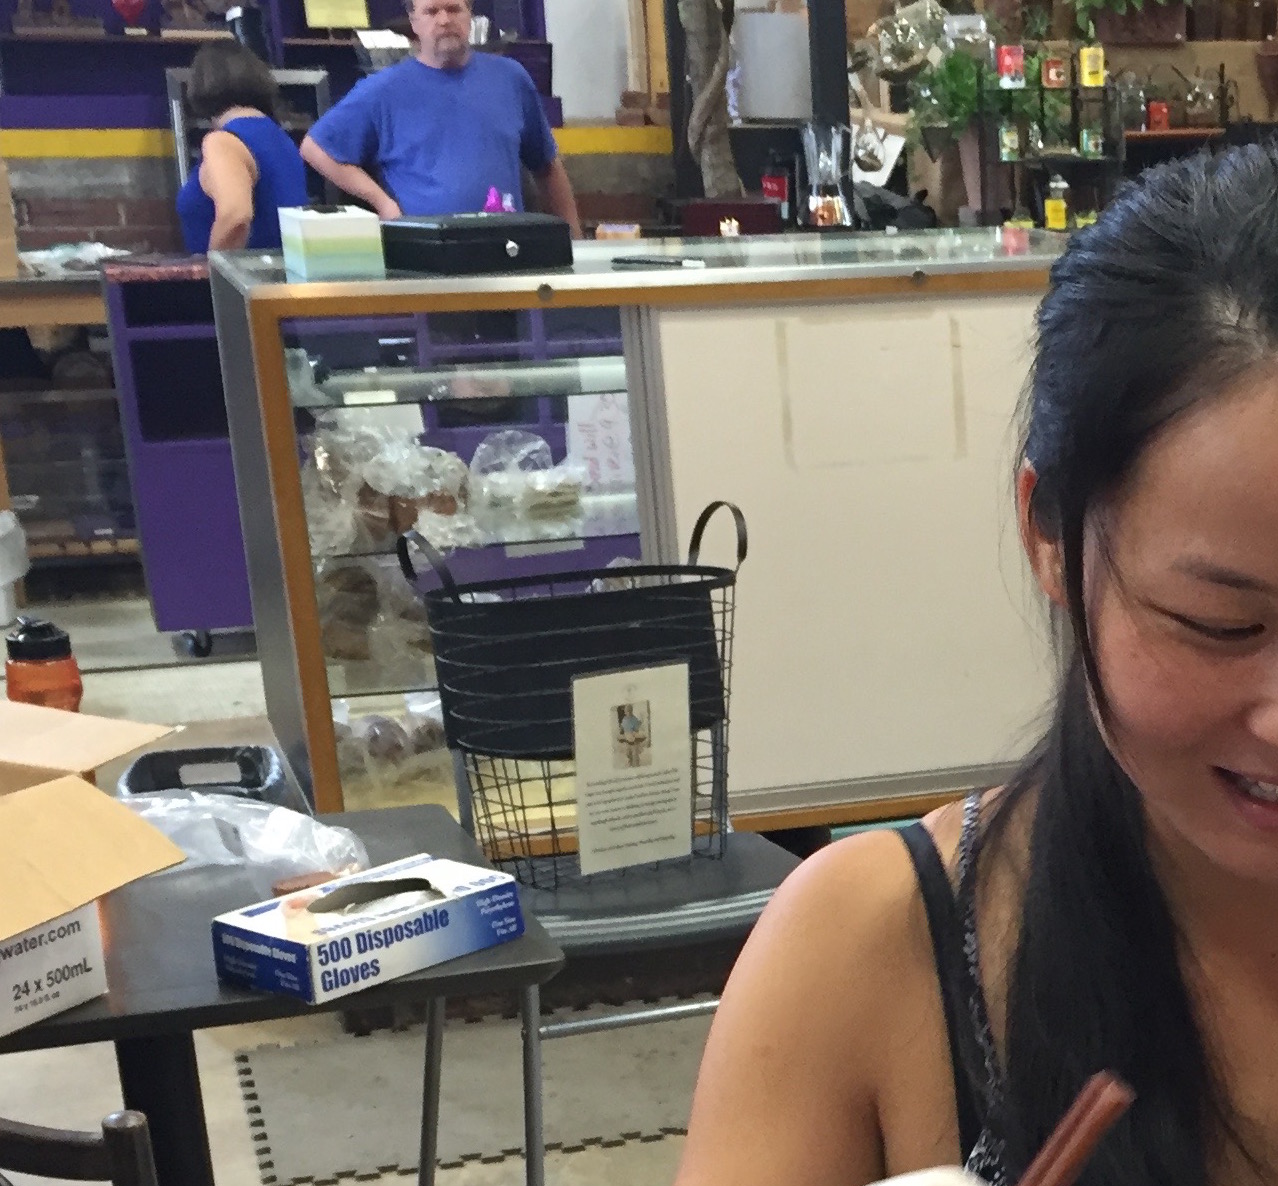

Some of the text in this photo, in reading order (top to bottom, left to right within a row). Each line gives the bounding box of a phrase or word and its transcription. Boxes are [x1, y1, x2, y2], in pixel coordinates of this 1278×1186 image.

[316, 937, 352, 966] 500
[355, 908, 450, 954] Disposable
[12, 957, 93, 1001] 24 x 500mL
[320, 958, 381, 993] Gloves
